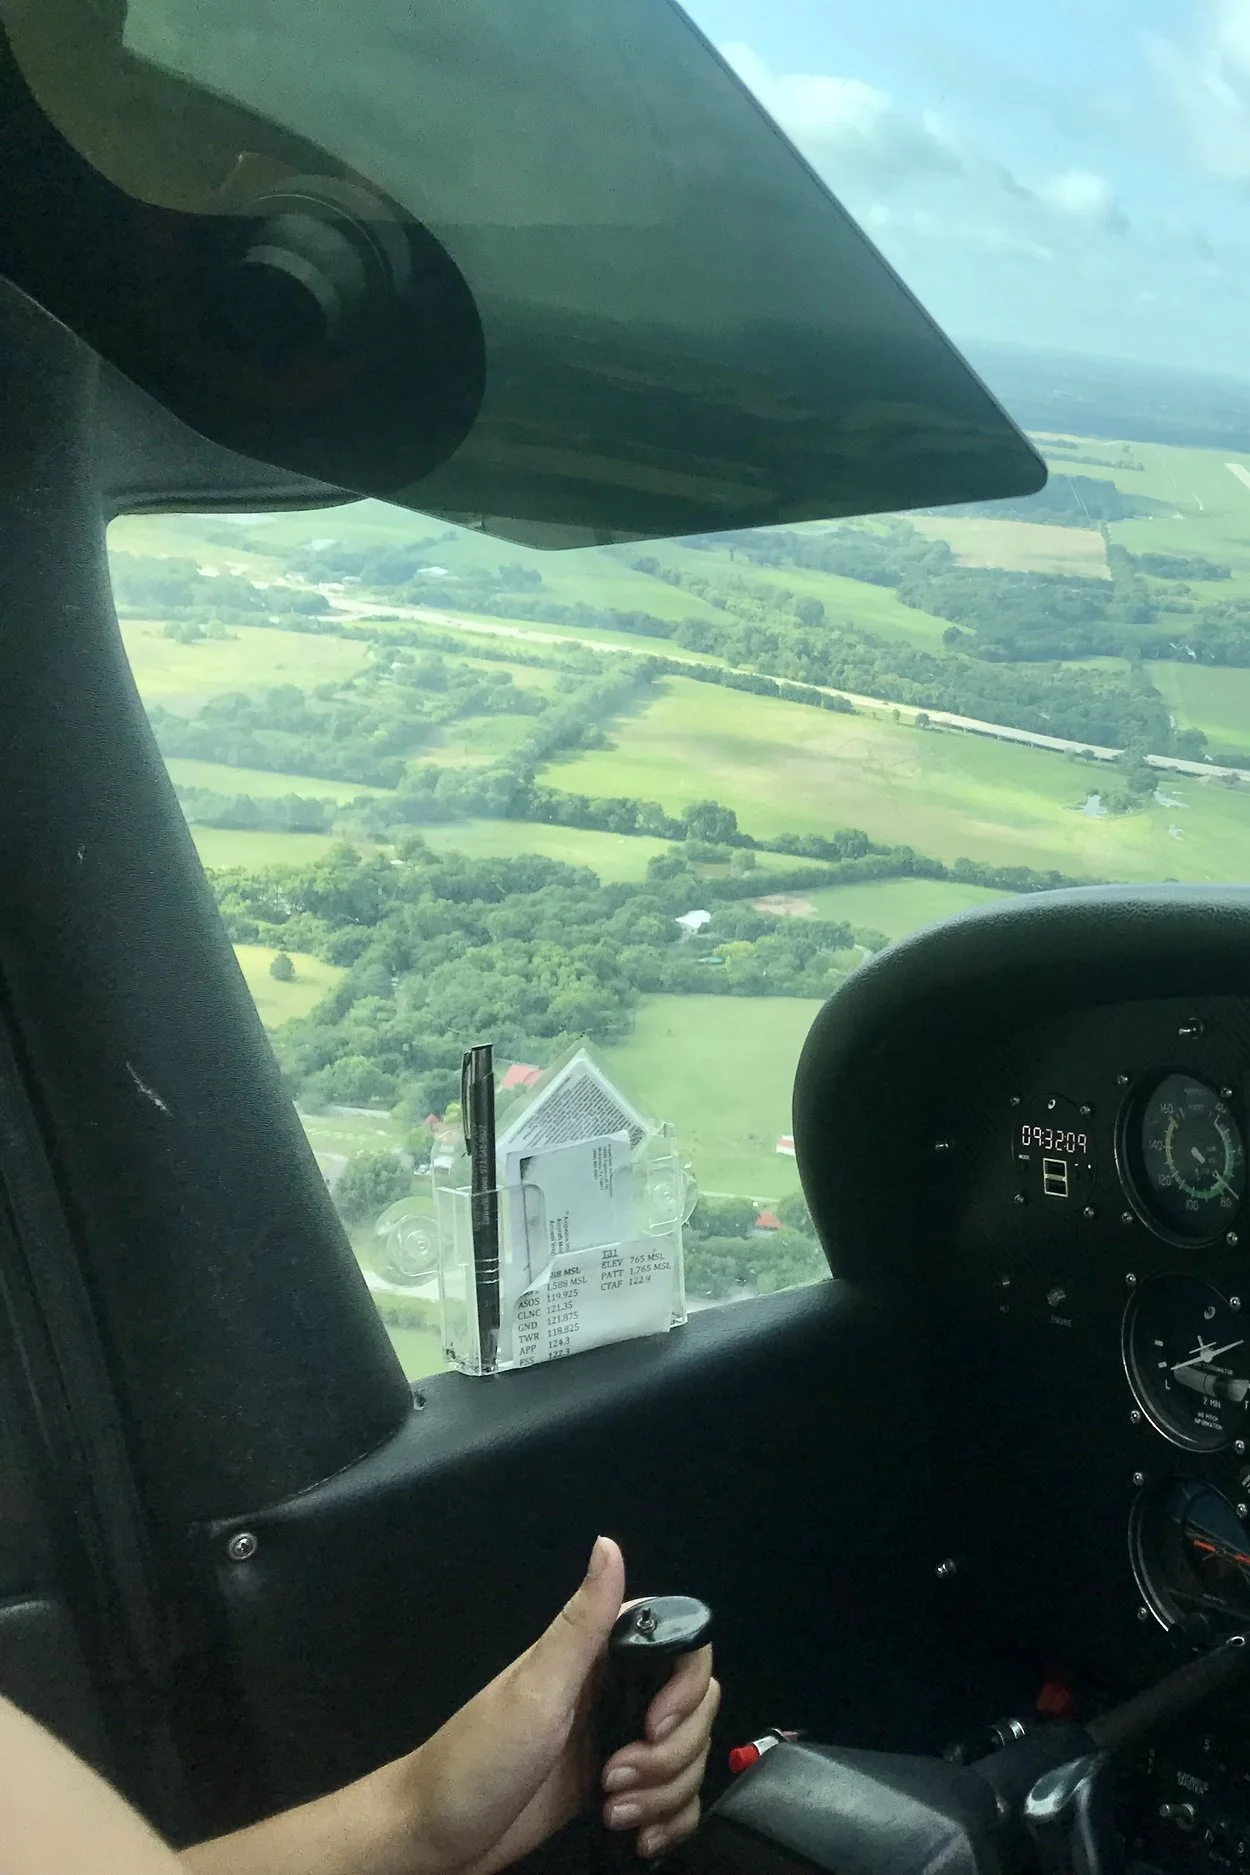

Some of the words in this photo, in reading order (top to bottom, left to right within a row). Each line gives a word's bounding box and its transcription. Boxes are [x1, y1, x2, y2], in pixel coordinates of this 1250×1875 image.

[601, 1269, 624, 1280] PATT
[517, 1297, 540, 1310] ASOS
[546, 1289, 578, 1303] 119.925
[546, 1301, 573, 1314] 121.35
[518, 1321, 538, 1332] GND
[547, 1311, 579, 1326] 121.875
[518, 1332, 540, 1344] TWR
[519, 1344, 537, 1356] APP
